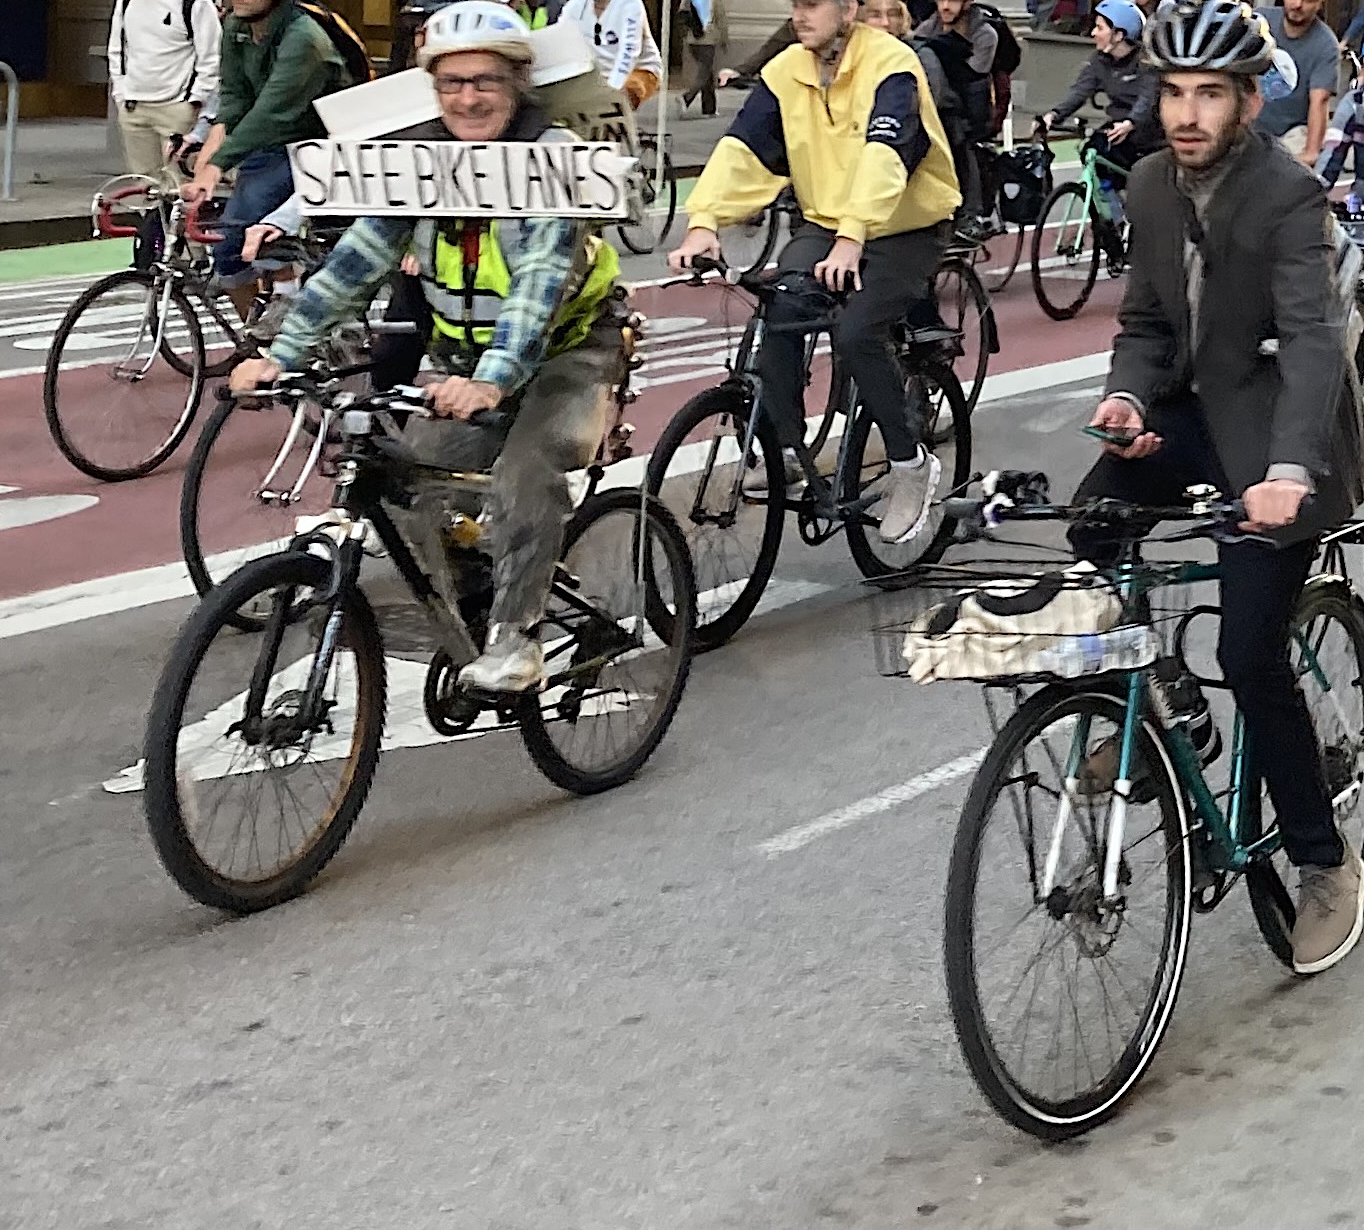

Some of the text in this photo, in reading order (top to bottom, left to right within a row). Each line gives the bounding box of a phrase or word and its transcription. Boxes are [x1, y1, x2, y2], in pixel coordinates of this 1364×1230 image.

[296, 140, 619, 211] SAFE BIKE LANES
